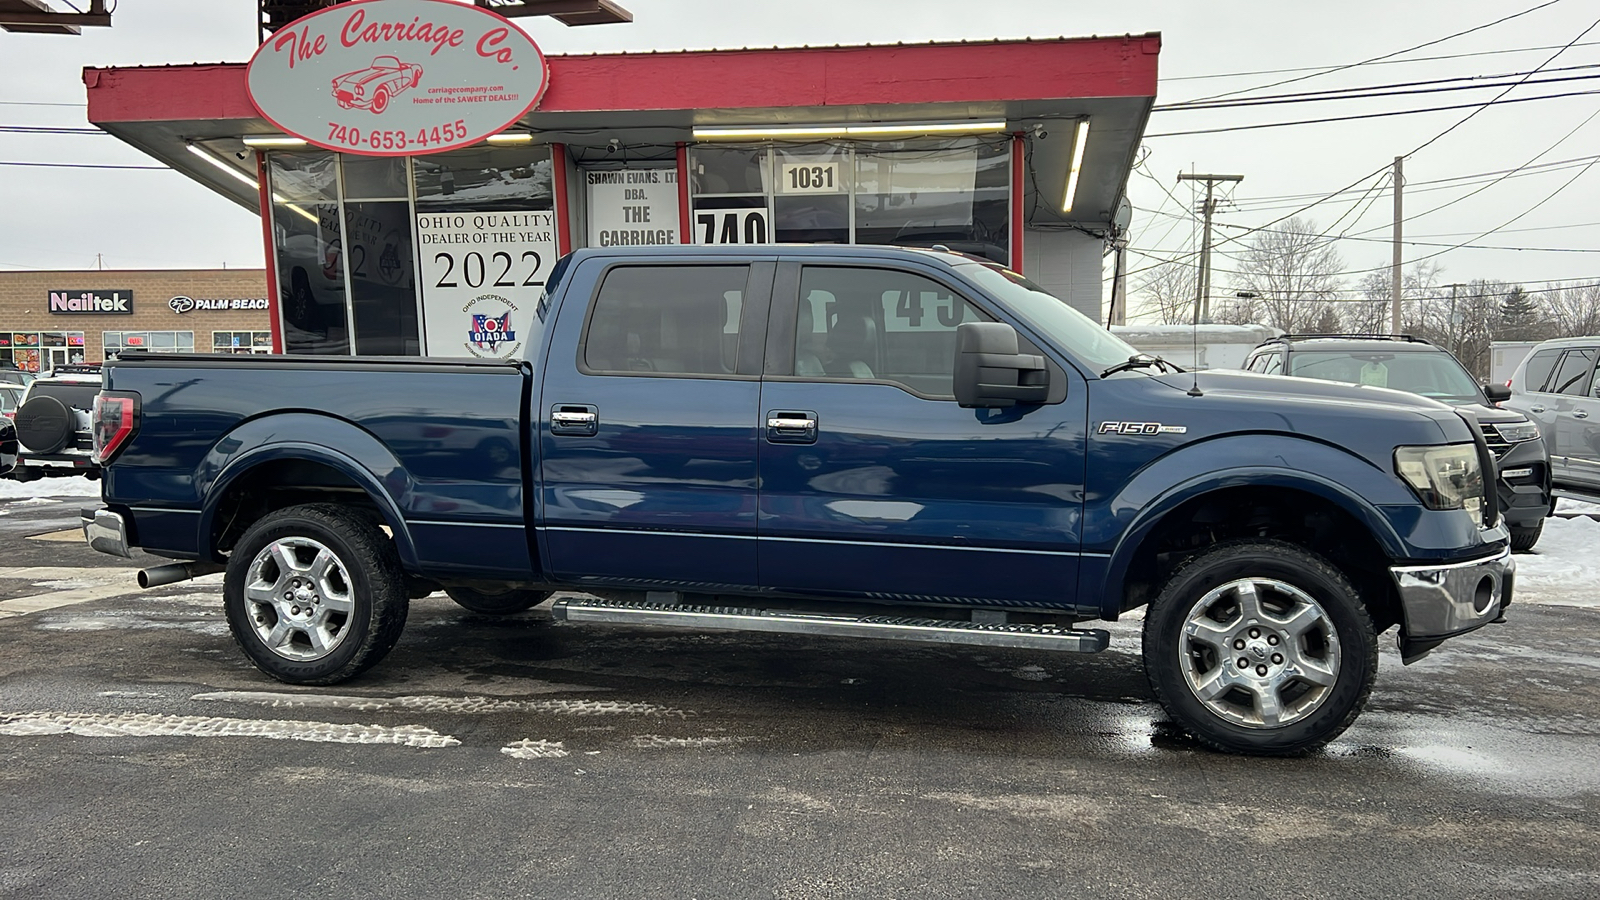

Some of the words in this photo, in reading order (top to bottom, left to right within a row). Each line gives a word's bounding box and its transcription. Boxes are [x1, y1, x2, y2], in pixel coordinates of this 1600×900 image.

[275, 26, 328, 69] The
[340, 9, 464, 56] Carriage
[476, 27, 519, 71] Co.
[427, 85, 504, 95] carriagecompany.com
[435, 96, 443, 104] of
[457, 95, 488, 103] SAWEET
[328, 119, 467, 150] 740-653-4455
[588, 172, 625, 185] SHAWN
[627, 172, 661, 185] EVANS.
[788, 166, 833, 189] 1031
[624, 188, 648, 200] DBA.
[419, 216, 465, 229] OHIO
[473, 214, 552, 230] QUALITY
[623, 206, 650, 223] THE
[697, 212, 766, 244] 740
[422, 233, 469, 245] DEALER
[472, 233, 489, 244] OF
[491, 232, 516, 243] THE
[518, 231, 552, 242] YEAR
[599, 229, 674, 247] CARRIAGE
[434, 251, 545, 288] 2022
[51, 292, 128, 312] Nailtek
[462, 299, 476, 313] OHIO
[476, 294, 519, 312] INDEPENDENT
[474, 332, 508, 342] OIADA
[1098, 421, 1162, 436] F-150
